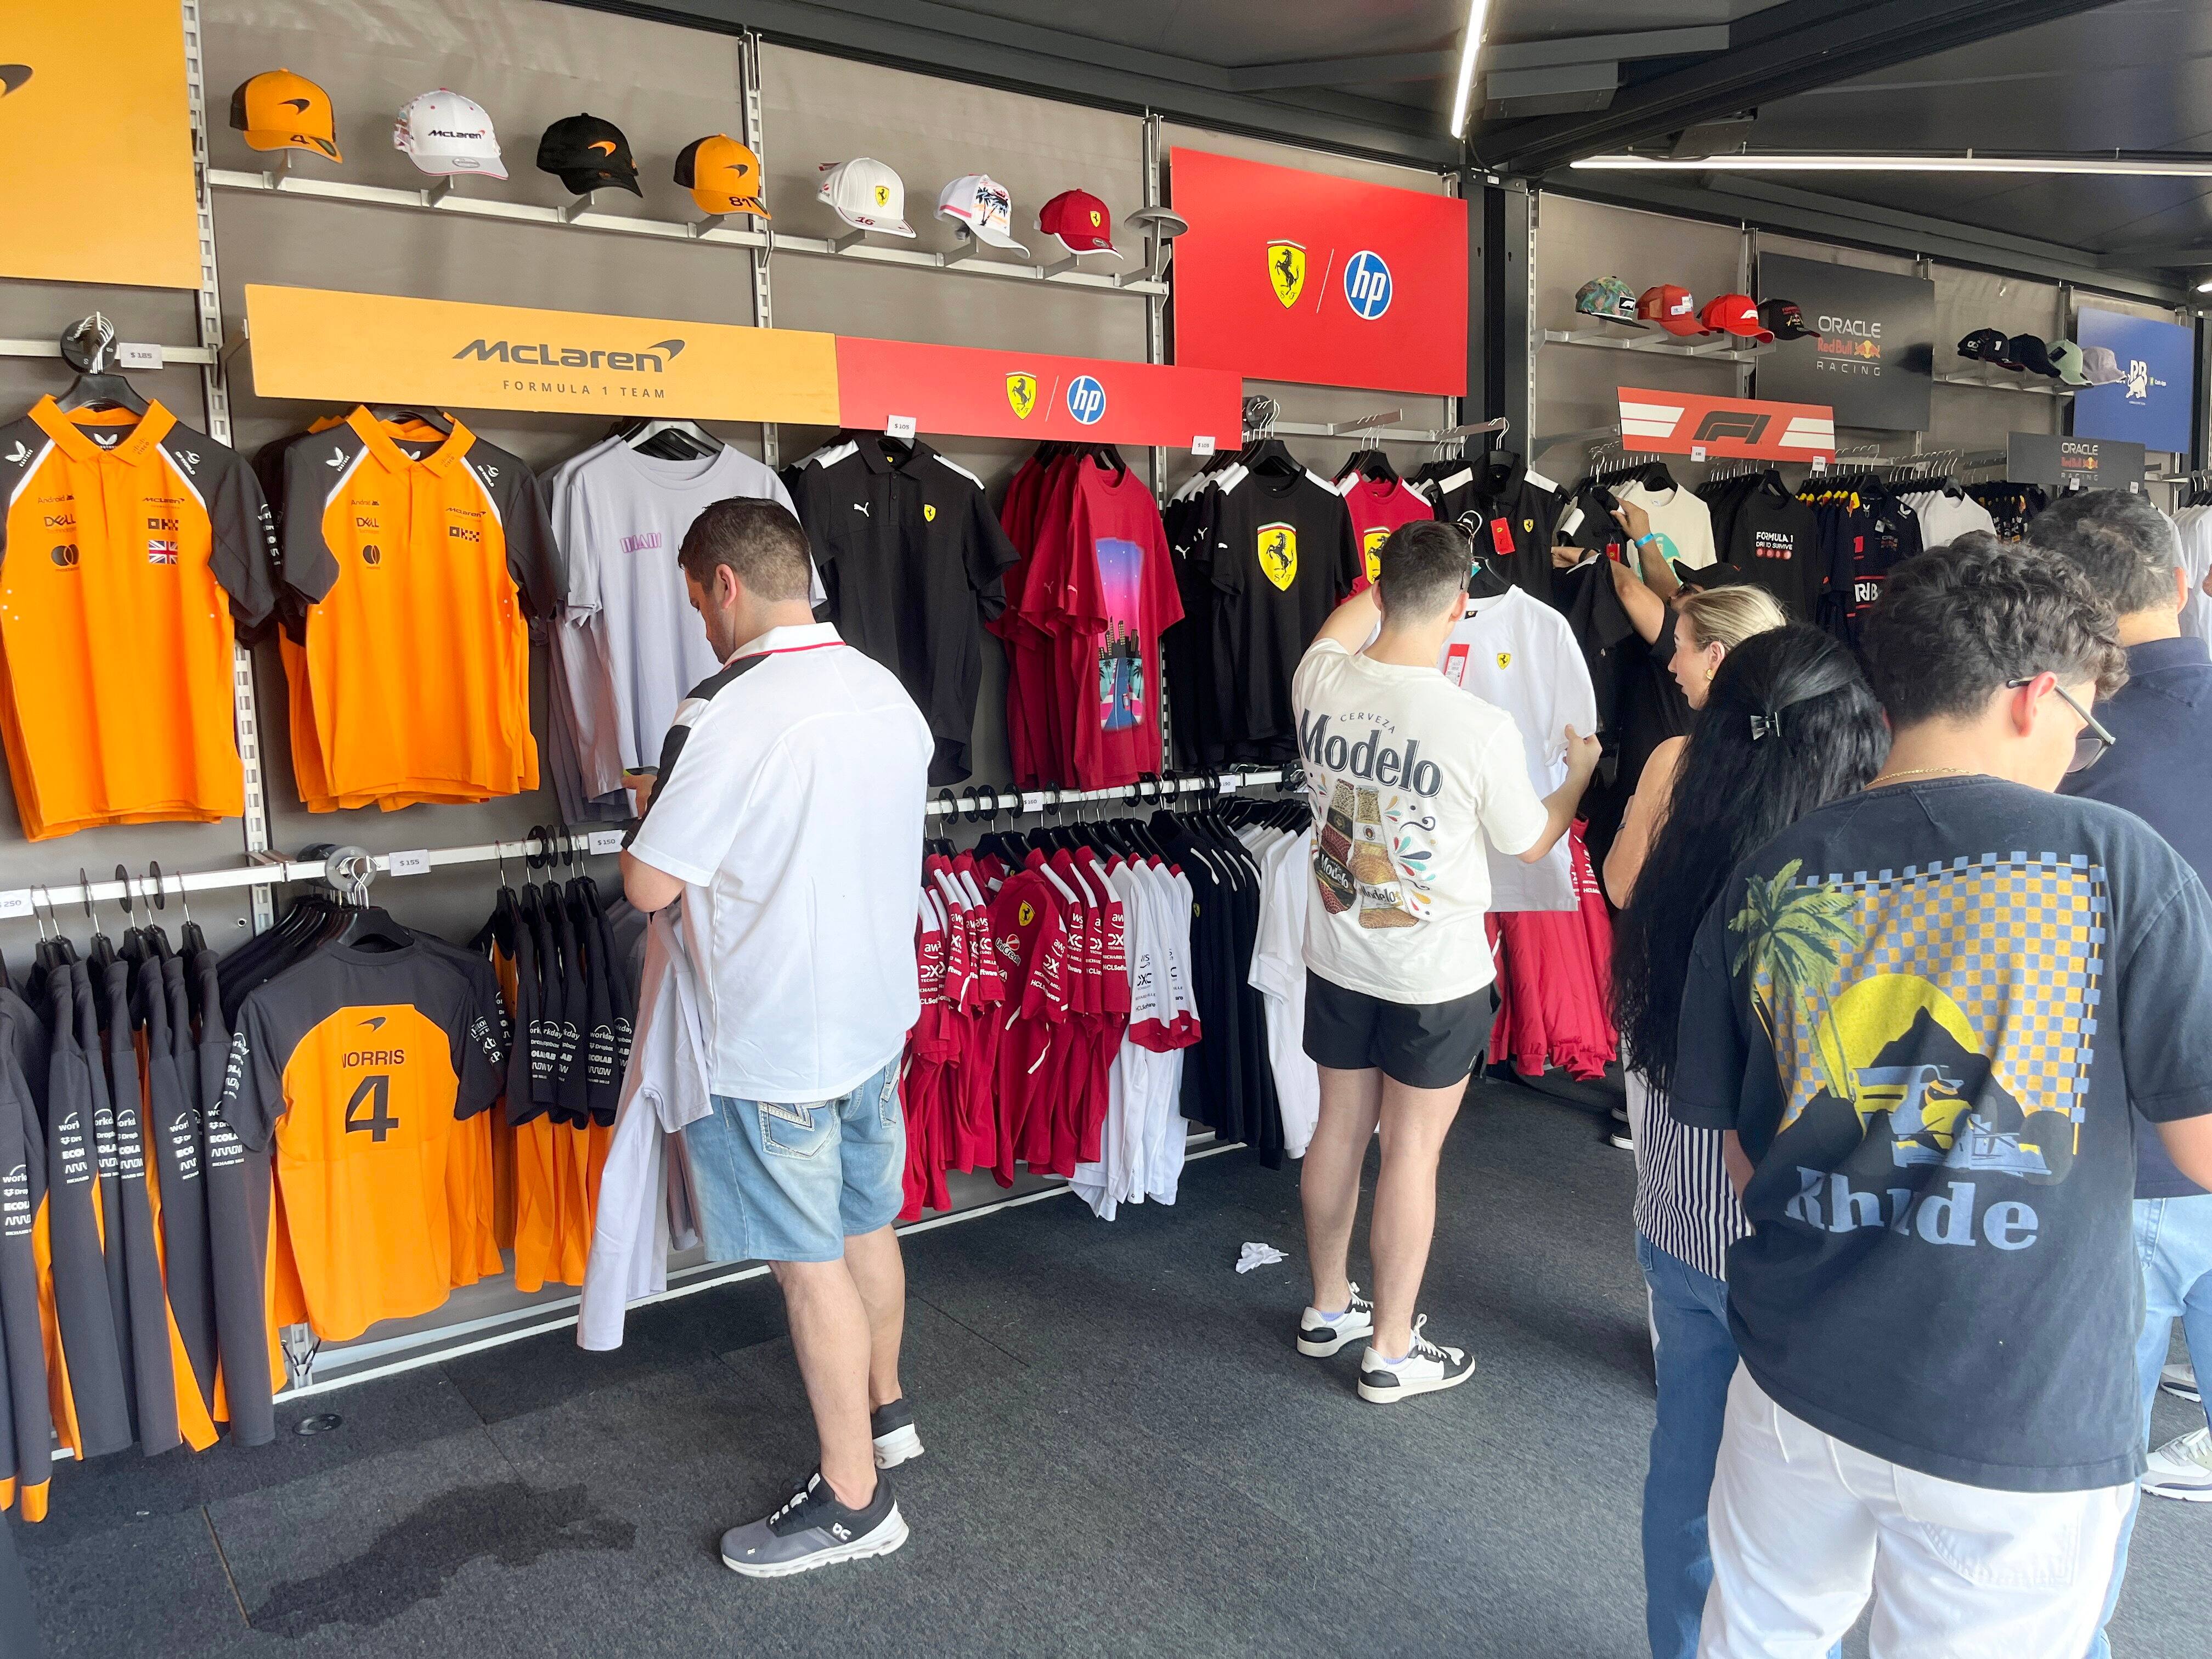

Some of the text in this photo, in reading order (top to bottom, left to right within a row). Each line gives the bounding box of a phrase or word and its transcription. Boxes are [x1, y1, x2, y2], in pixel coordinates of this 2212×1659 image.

[428, 130, 486, 139] McLaren
[729, 196, 753, 208] 81
[855, 217, 876, 225] 16
[1348, 251, 1390, 319] hp
[1818, 315, 1881, 338] ORACLE
[452, 339, 685, 373] McLaren
[1816, 361, 1881, 376] RACING
[503, 380, 665, 399] FORMULA 1 TEAM
[1070, 376, 1104, 424] hp
[2061, 442, 2099, 456] ORACLE
[44, 514, 76, 527] DELL
[356, 517, 380, 528] DELL
[1756, 531, 1793, 543] FORMULA 1
[1340, 712, 1396, 734] CERVEZA
[1299, 707, 1443, 799] Modelo
[3, 900, 22, 908] 250
[1111, 913, 1124, 922] aw
[1068, 933, 1083, 948] XC
[1108, 933, 1124, 946] DX
[341, 1049, 405, 1069] NORRIS
[345, 1075, 399, 1143] 4
[209, 1132, 239, 1144] ECOLA
[2, 1173, 27, 1183] work
